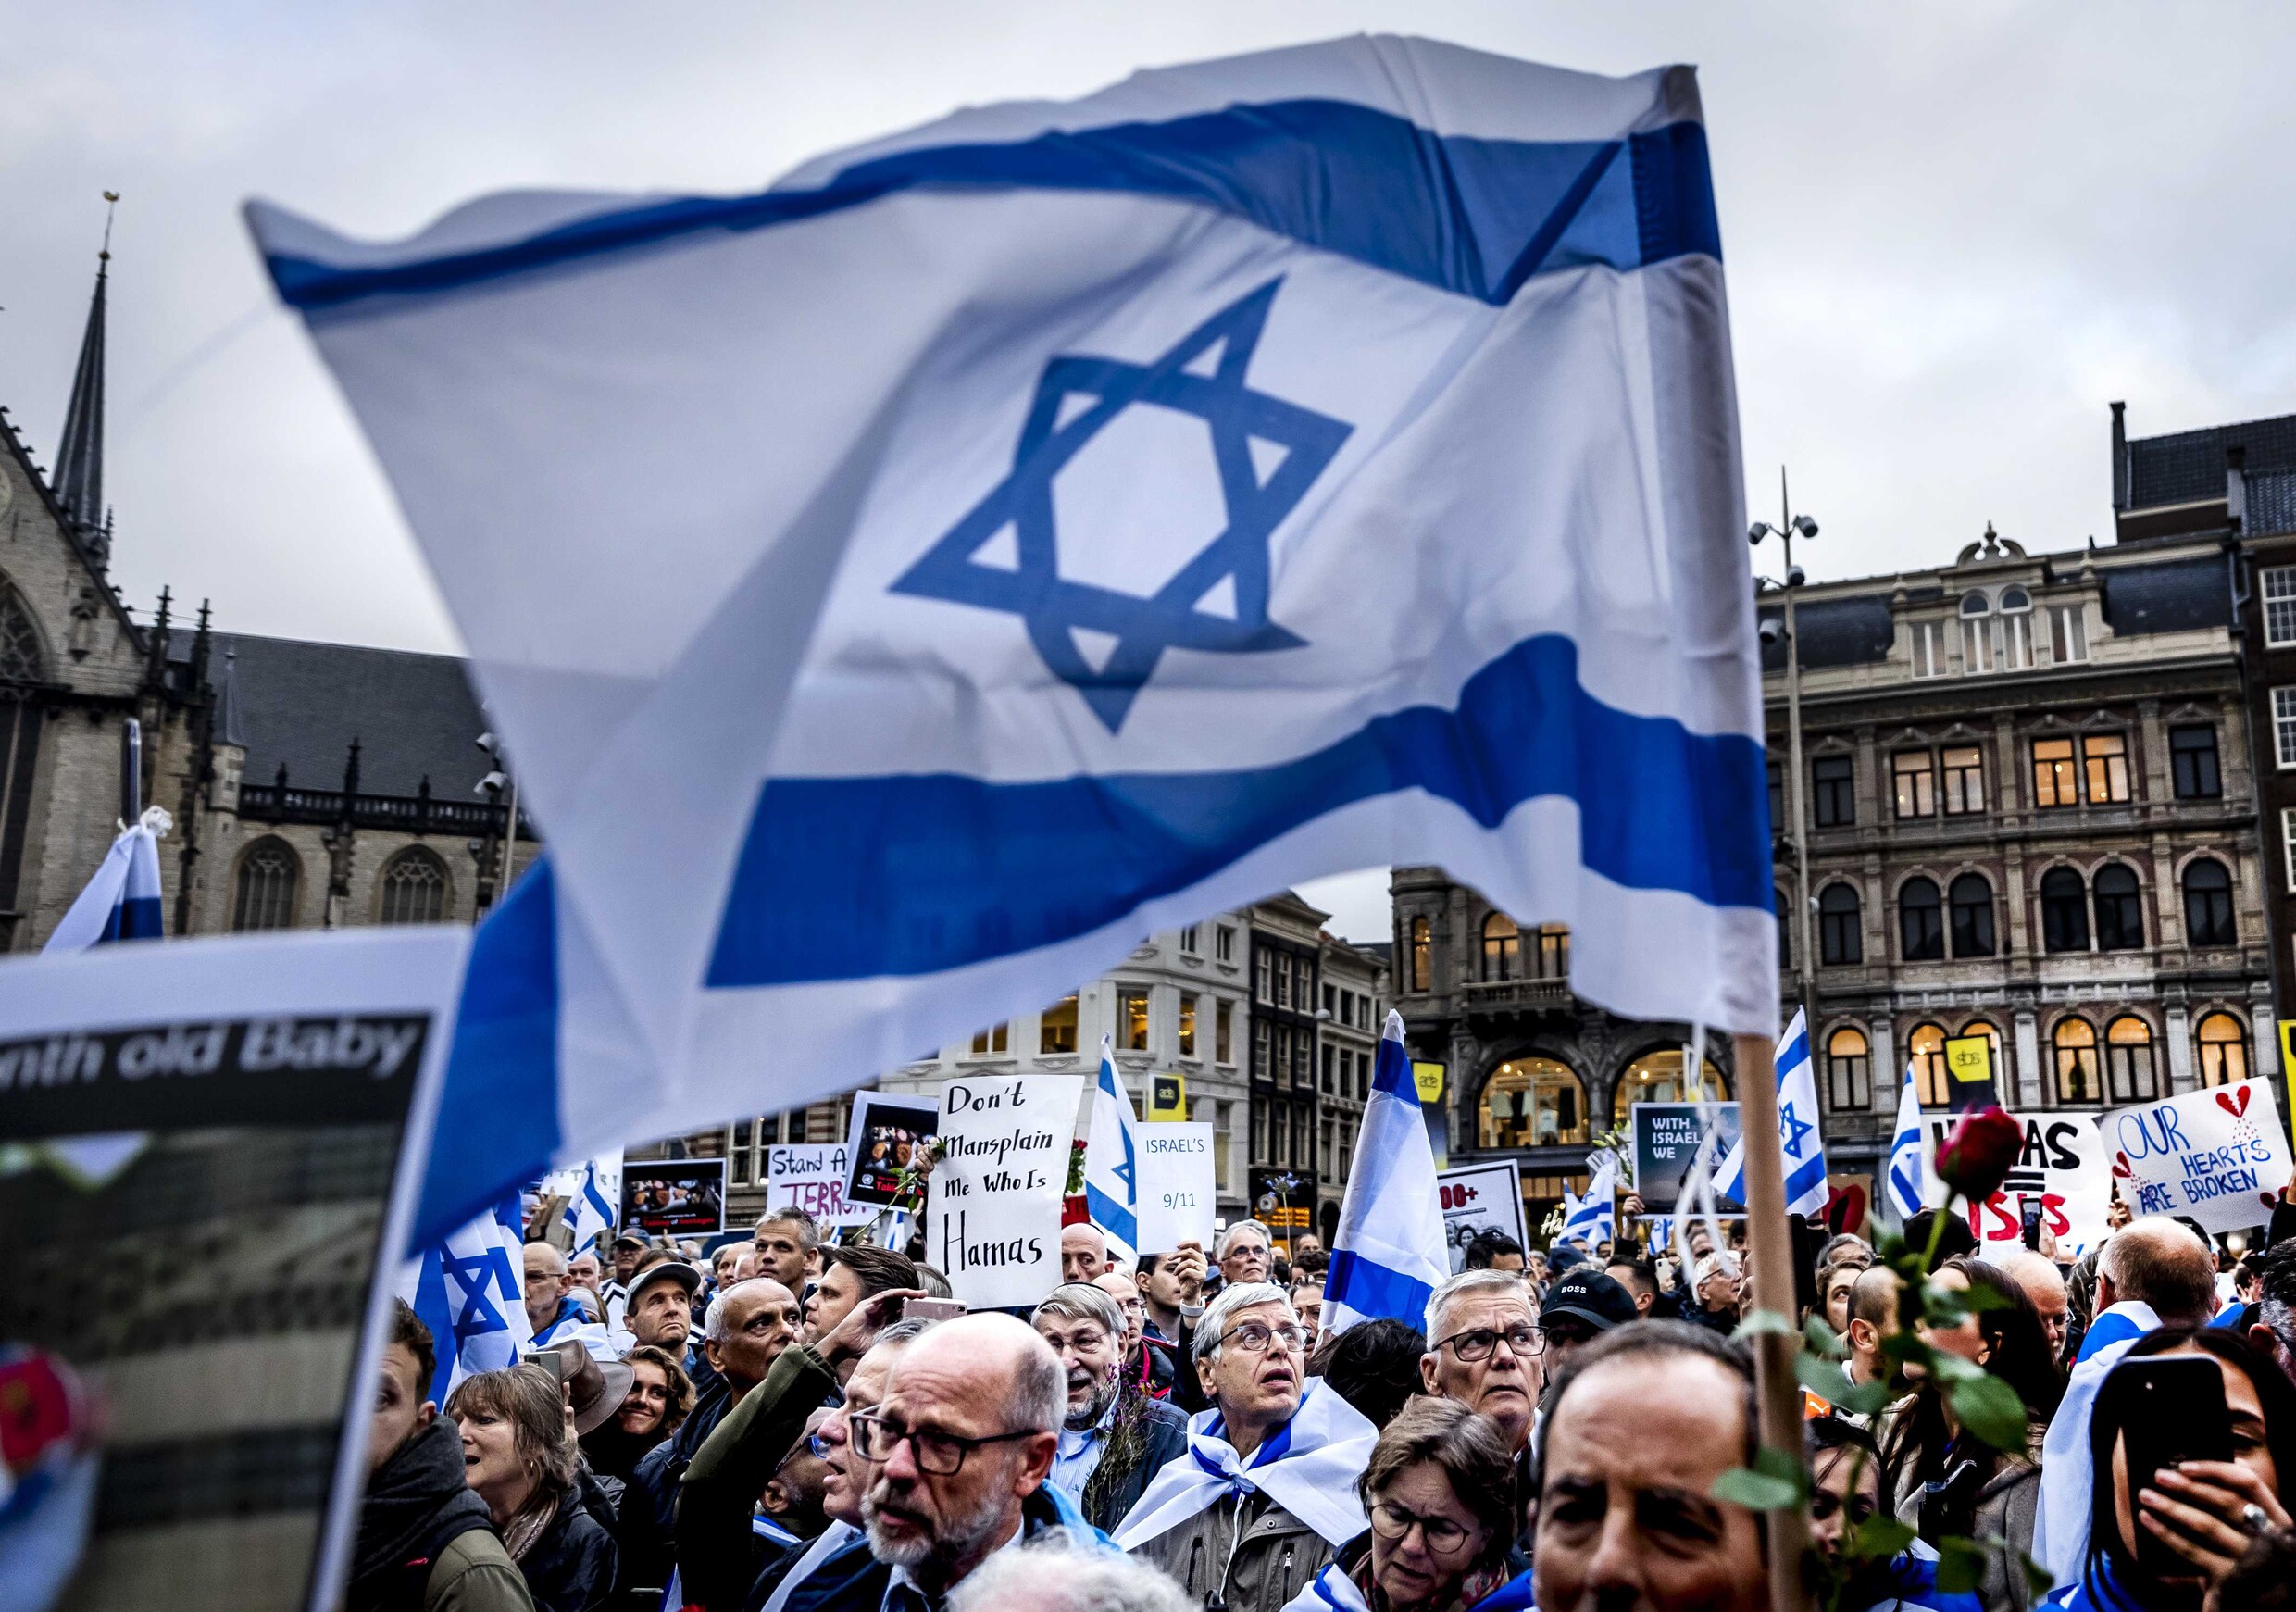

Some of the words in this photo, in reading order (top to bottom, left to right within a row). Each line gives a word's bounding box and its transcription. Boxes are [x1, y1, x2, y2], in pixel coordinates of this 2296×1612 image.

[117, 1022, 229, 1080] old
[239, 1016, 419, 1080] Baby
[947, 1081, 1026, 1114] Don't
[1652, 1118, 1691, 1130] WITH
[1653, 1131, 1702, 1144] ISRAEL
[2118, 1105, 2190, 1159] OUR
[1146, 1138, 1204, 1153] ISRAEL'S
[1653, 1146, 1676, 1159] WE
[2180, 1139, 2271, 1178] HEARTS
[772, 1149, 823, 1175] Stand
[983, 1171, 1021, 1193] Who
[1026, 1169, 1046, 1190] Is
[2138, 1182, 2177, 1215] ARE
[2181, 1168, 2259, 1204] BROKEN
[780, 1181, 867, 1217] TERR
[1163, 1193, 1196, 1210] 9/11
[1967, 1190, 2071, 1242] ISS
[943, 1210, 1042, 1276] Hamas
[1561, 1285, 1587, 1294] BOSS
